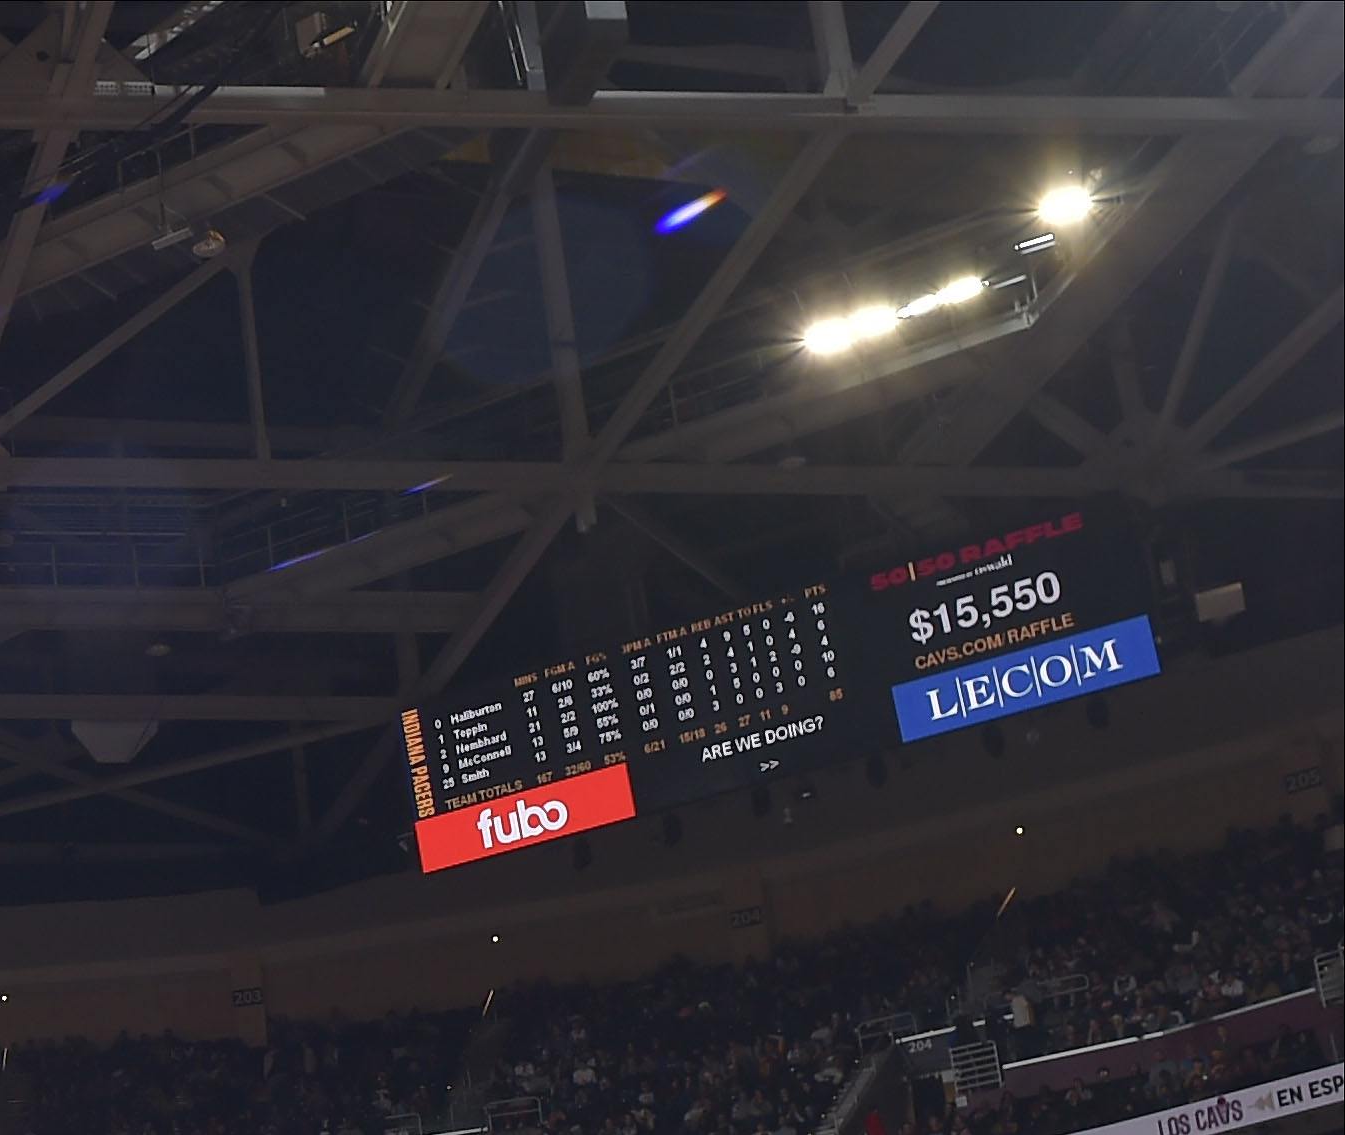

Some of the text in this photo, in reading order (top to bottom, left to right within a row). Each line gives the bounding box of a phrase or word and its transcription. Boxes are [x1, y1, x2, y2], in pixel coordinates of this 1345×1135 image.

[908, 571, 1061, 644] $15,550
[450, 701, 504, 726] Haliburton
[455, 730, 508, 755] Nembhard
[457, 744, 512, 770] McConnell
[701, 715, 825, 763] ARE WE DOING?
[411, 764, 436, 818] PACERS
[445, 779, 523, 811] TEAM TOTALS
[461, 767, 490, 785] Smith
[476, 799, 569, 849] fubo
[1195, 1097, 1243, 1131] CAVS
[1277, 1086, 1304, 1108] EN
